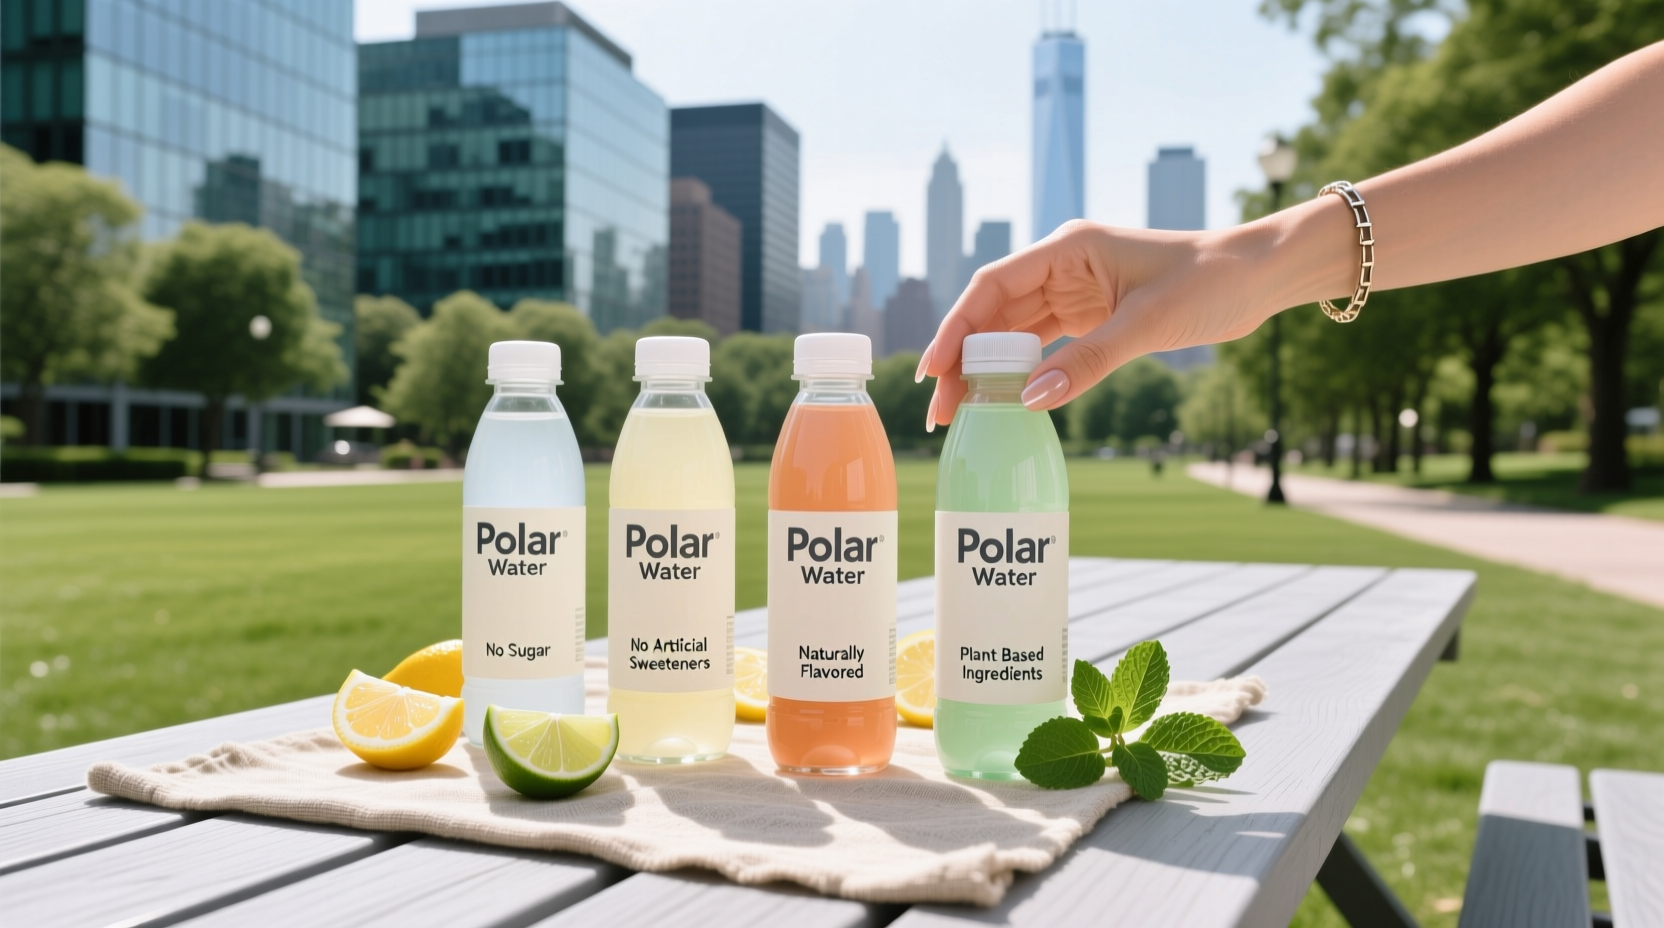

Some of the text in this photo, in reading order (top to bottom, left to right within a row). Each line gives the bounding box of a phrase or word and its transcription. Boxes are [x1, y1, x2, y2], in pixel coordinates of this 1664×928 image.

[488, 559, 547, 576] Water
[639, 562, 701, 580] Water
[801, 566, 865, 584] Water
[972, 567, 1037, 586] Water
[487, 642, 551, 661] No Sugar
[631, 637, 648, 652] No
[799, 645, 864, 662] Naturally
[961, 646, 1043, 662] Plant Based
[630, 656, 710, 670] Sweeteners
[801, 664, 863, 679] Flavored
[963, 665, 1042, 683] Ingredients
